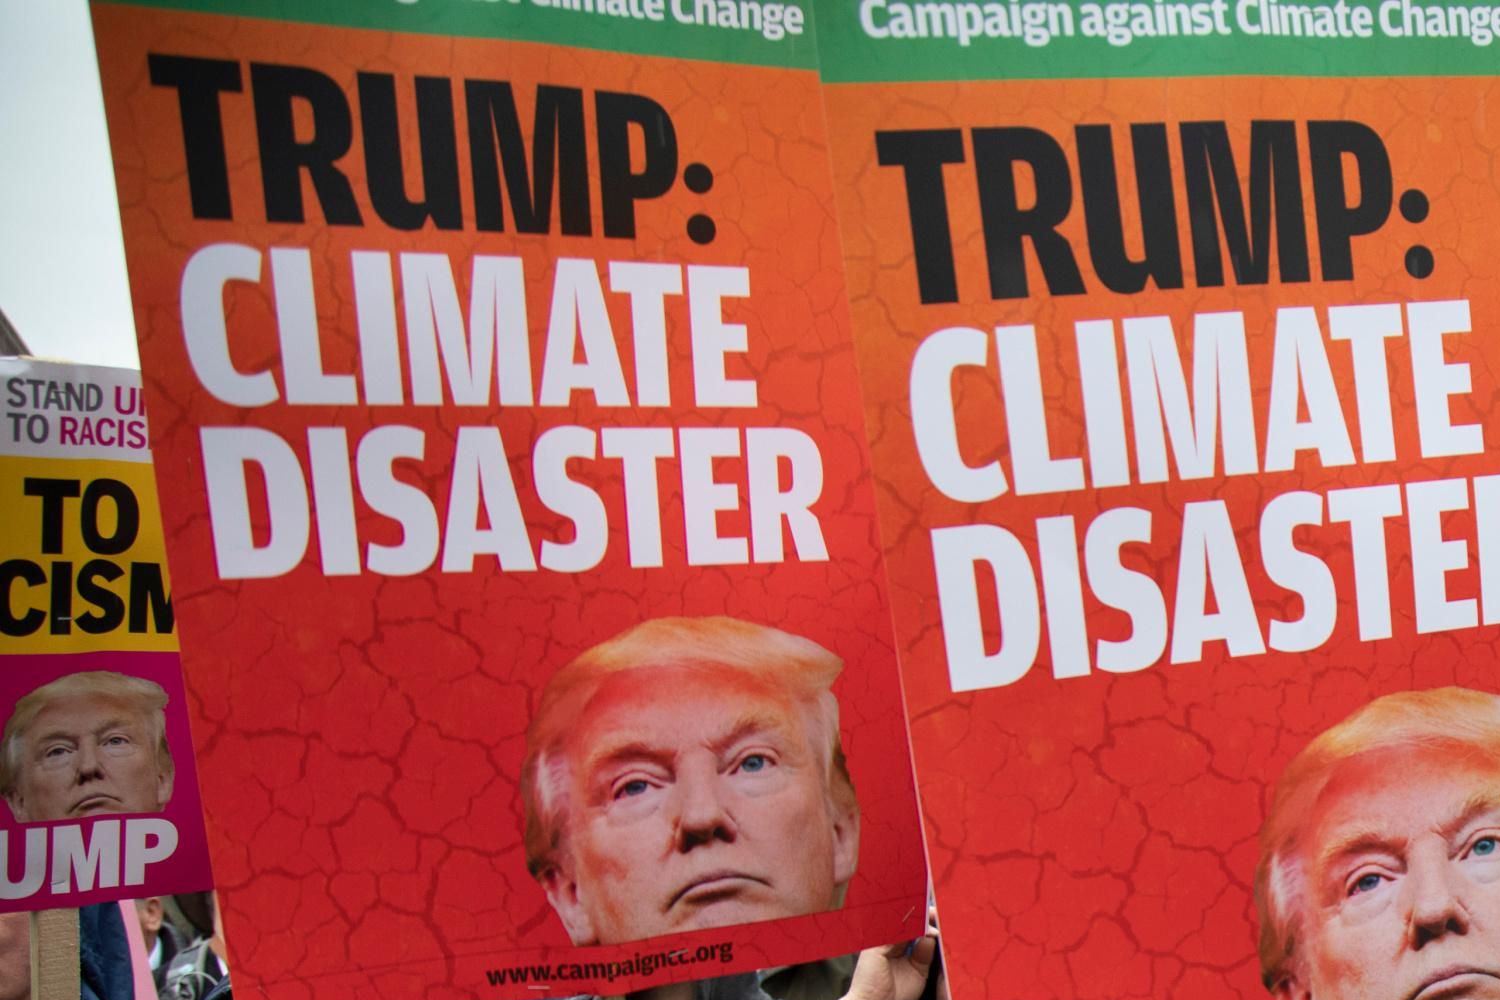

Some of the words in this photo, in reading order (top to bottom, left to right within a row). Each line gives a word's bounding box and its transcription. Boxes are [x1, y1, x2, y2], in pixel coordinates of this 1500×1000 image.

[671, 0, 804, 41] Change
[859, 0, 1075, 47] Campaign
[1080, 0, 1232, 47] against
[1236, 0, 1374, 38] Climate
[148, 52, 717, 245] TRUMP:
[875, 119, 1435, 305] TRUMP:
[180, 243, 758, 408] CLIMATE
[6, 377, 104, 412] STAND
[6, 411, 49, 444] TO
[59, 416, 147, 450] RACIS
[909, 299, 1485, 503] CLIMATE
[24, 476, 140, 556] TO
[200, 425, 830, 580] DISASTER
[0, 558, 175, 637] CISM
[0, 816, 179, 900] UMP
[486, 941, 734, 987] www.campaigncc.org
